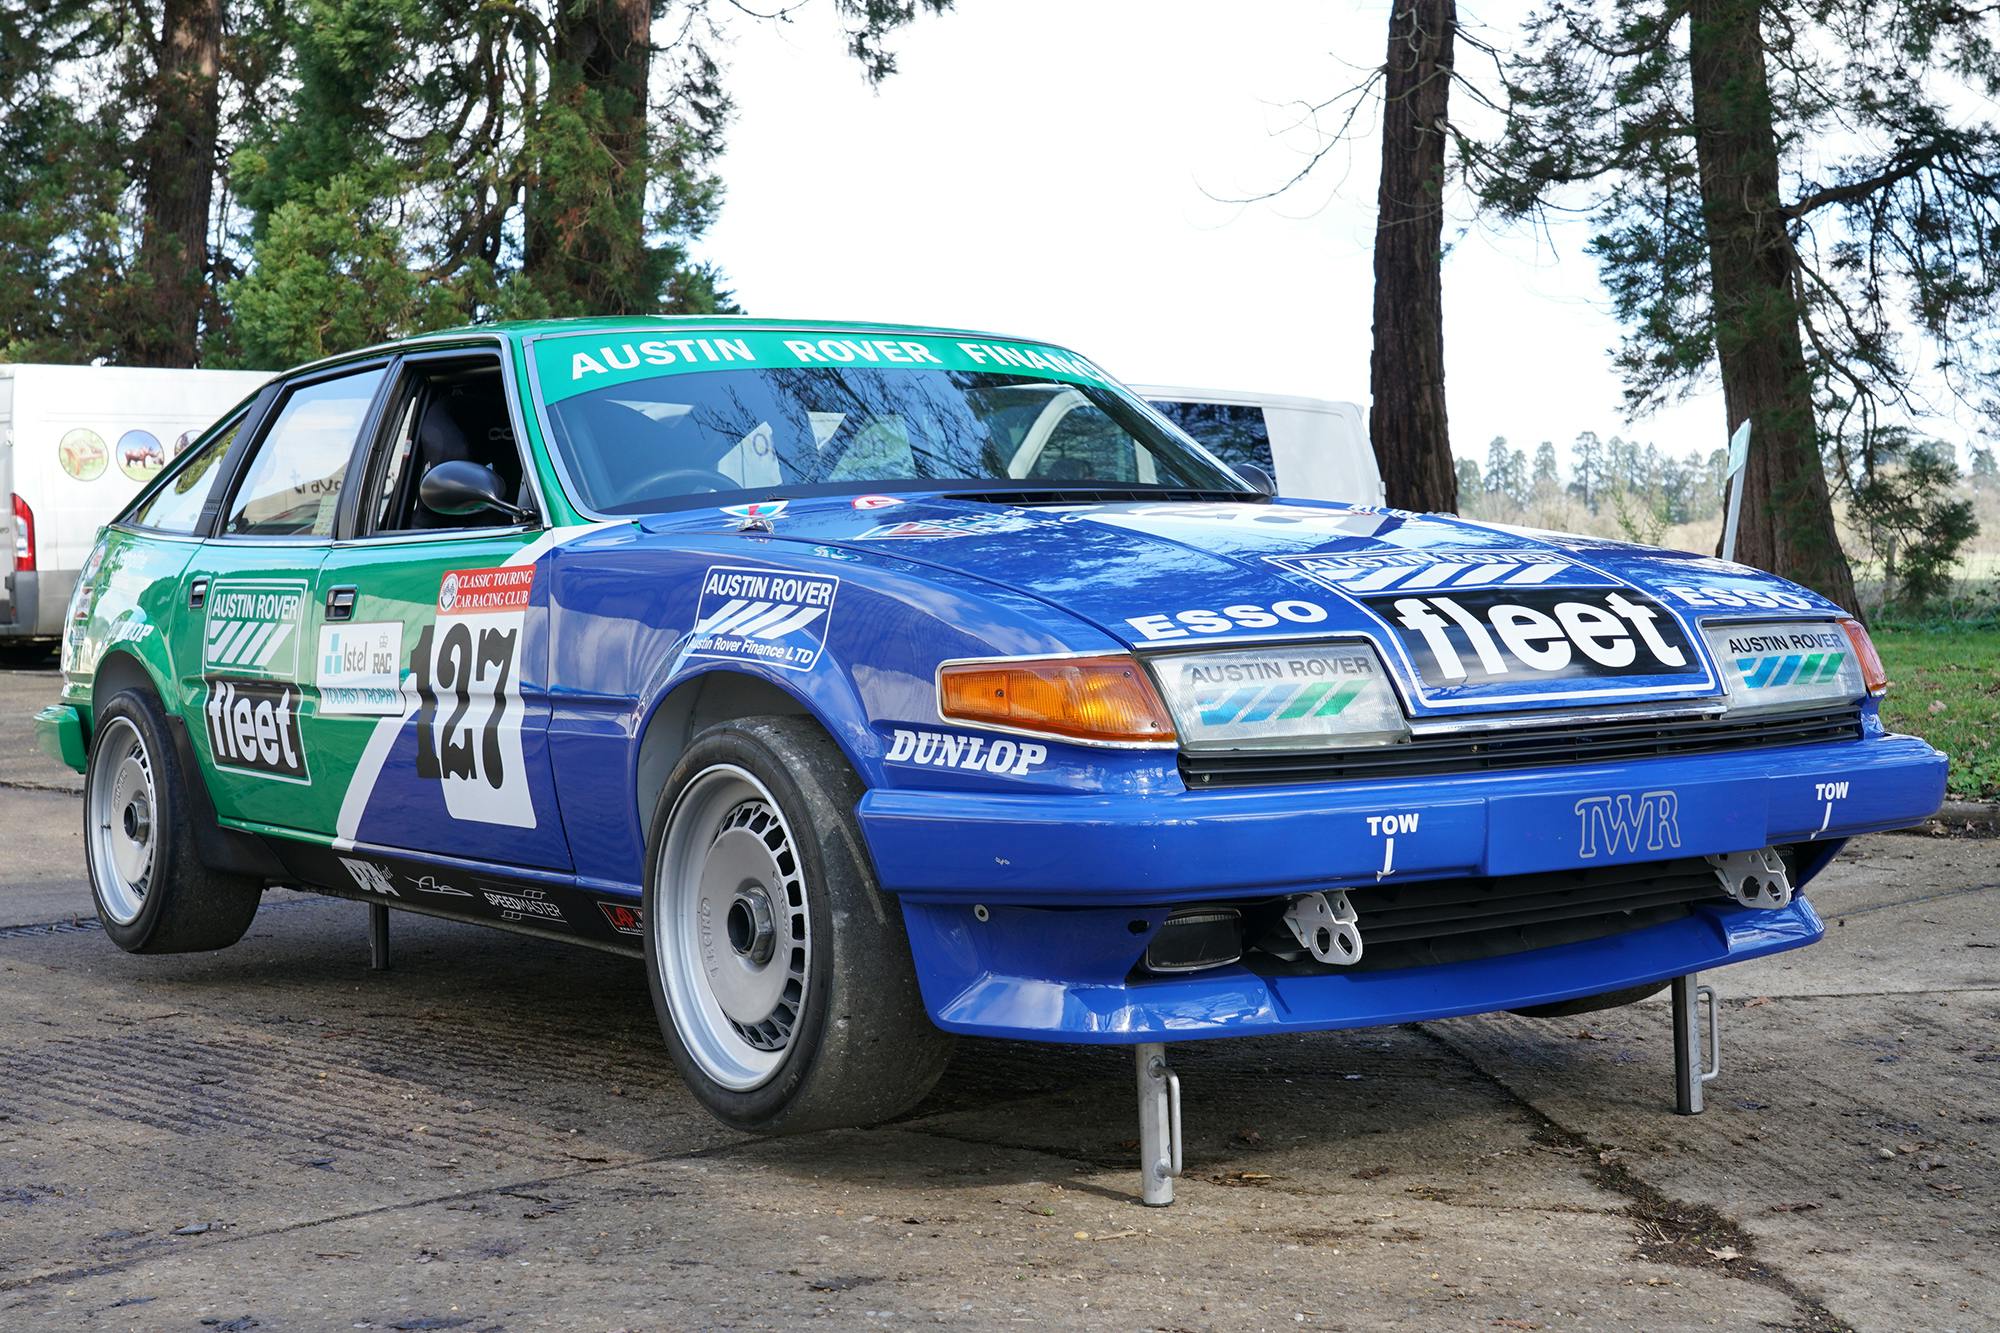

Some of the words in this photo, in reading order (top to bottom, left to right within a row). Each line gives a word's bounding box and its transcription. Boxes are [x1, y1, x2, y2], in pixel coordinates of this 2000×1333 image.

[572, 339, 756, 381] AUSTIN
[783, 340, 943, 364] ROVER
[957, 342, 1112, 386] FINANC
[1299, 552, 1442, 571] AUSTIN
[1440, 553, 1566, 564] ROVER
[459, 574, 493, 589] CLASSIC
[493, 570, 533, 586] TOURING
[705, 573, 769, 599] AUSTIN
[768, 578, 833, 606] ROVER
[211, 593, 256, 618] AUSTIN
[255, 594, 300, 620] ROVER
[454, 594, 472, 608] CAR
[472, 592, 505, 607] RACING
[505, 590, 529, 605] CLUB
[1663, 586, 1813, 610] ESSO
[1124, 600, 1328, 640] ESSO
[1393, 591, 1687, 680] fleet
[1729, 635, 1788, 653] AUSTIN
[1789, 632, 1845, 648] ROVER
[372, 653, 392, 674] RAC
[687, 636, 713, 650] Austin
[713, 637, 741, 651] Rover
[741, 639, 787, 658] Finance
[785, 646, 814, 664] LTD
[1191, 662, 1283, 684] AUSTIN
[1288, 657, 1373, 677] ROVER
[323, 687, 359, 704] TOURIST
[360, 687, 397, 704] TROPHY
[410, 622, 517, 790] 127
[208, 680, 298, 769] fleet
[885, 729, 1047, 776] DUNLOP
[1815, 781, 1849, 801] TOW
[1366, 813, 1419, 836] TOW
[1574, 790, 1681, 859] TWR
[483, 892, 562, 918] SPEEDMASTER
